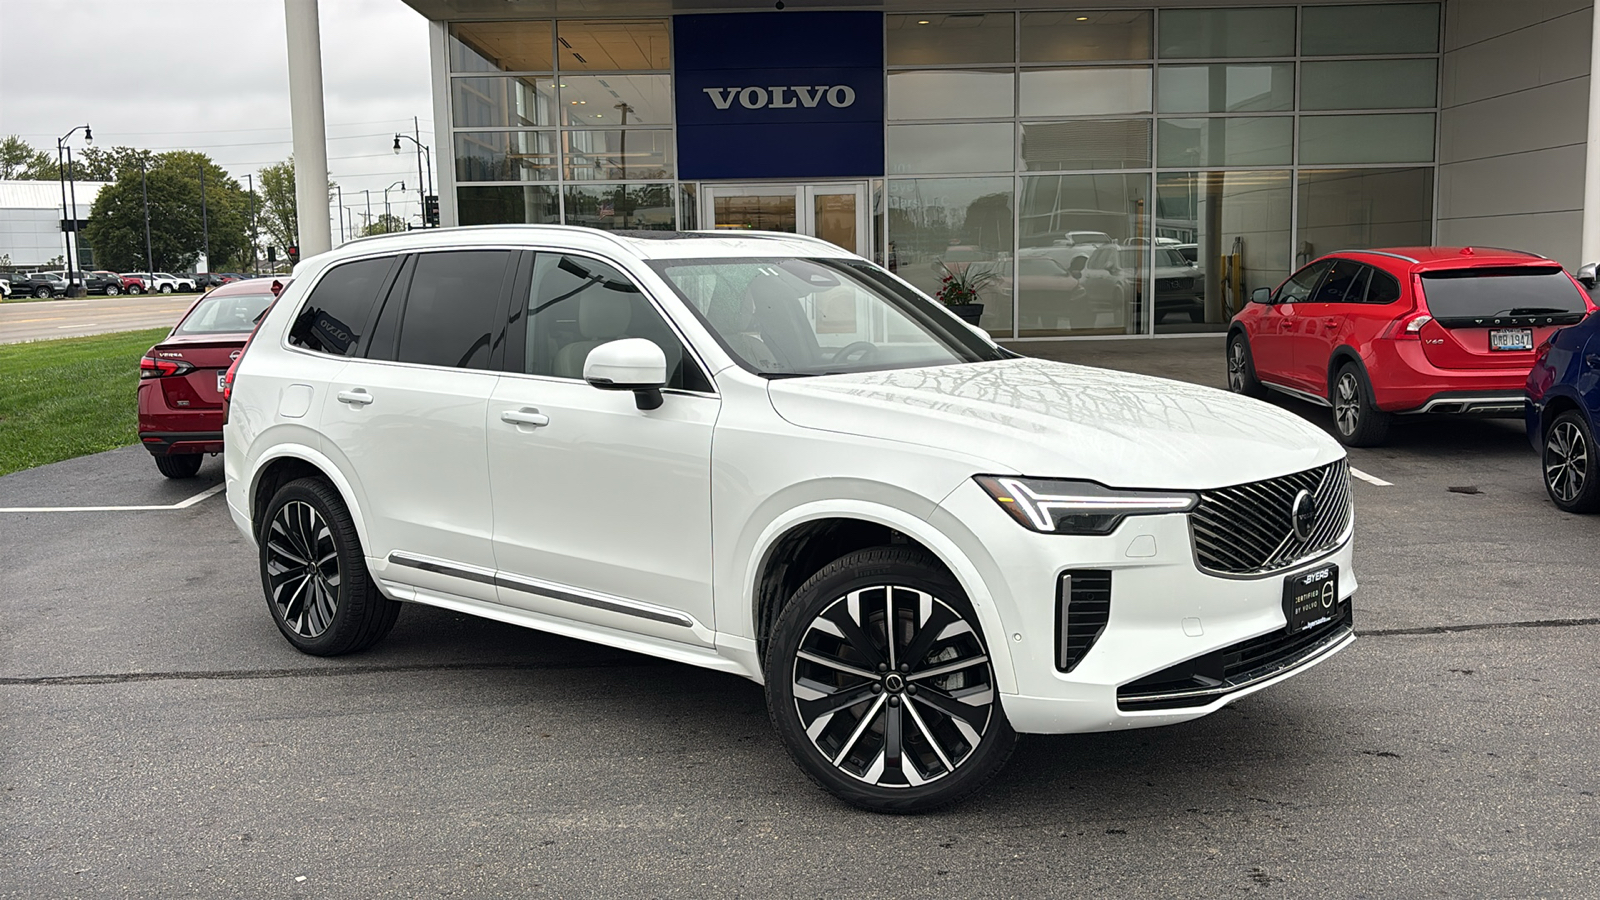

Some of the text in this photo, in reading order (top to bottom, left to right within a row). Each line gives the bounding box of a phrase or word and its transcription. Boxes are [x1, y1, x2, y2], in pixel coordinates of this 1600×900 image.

[702, 85, 856, 110] VOLVO
[1305, 569, 1329, 585] BYERS
[1302, 601, 1318, 612] VOLVO
